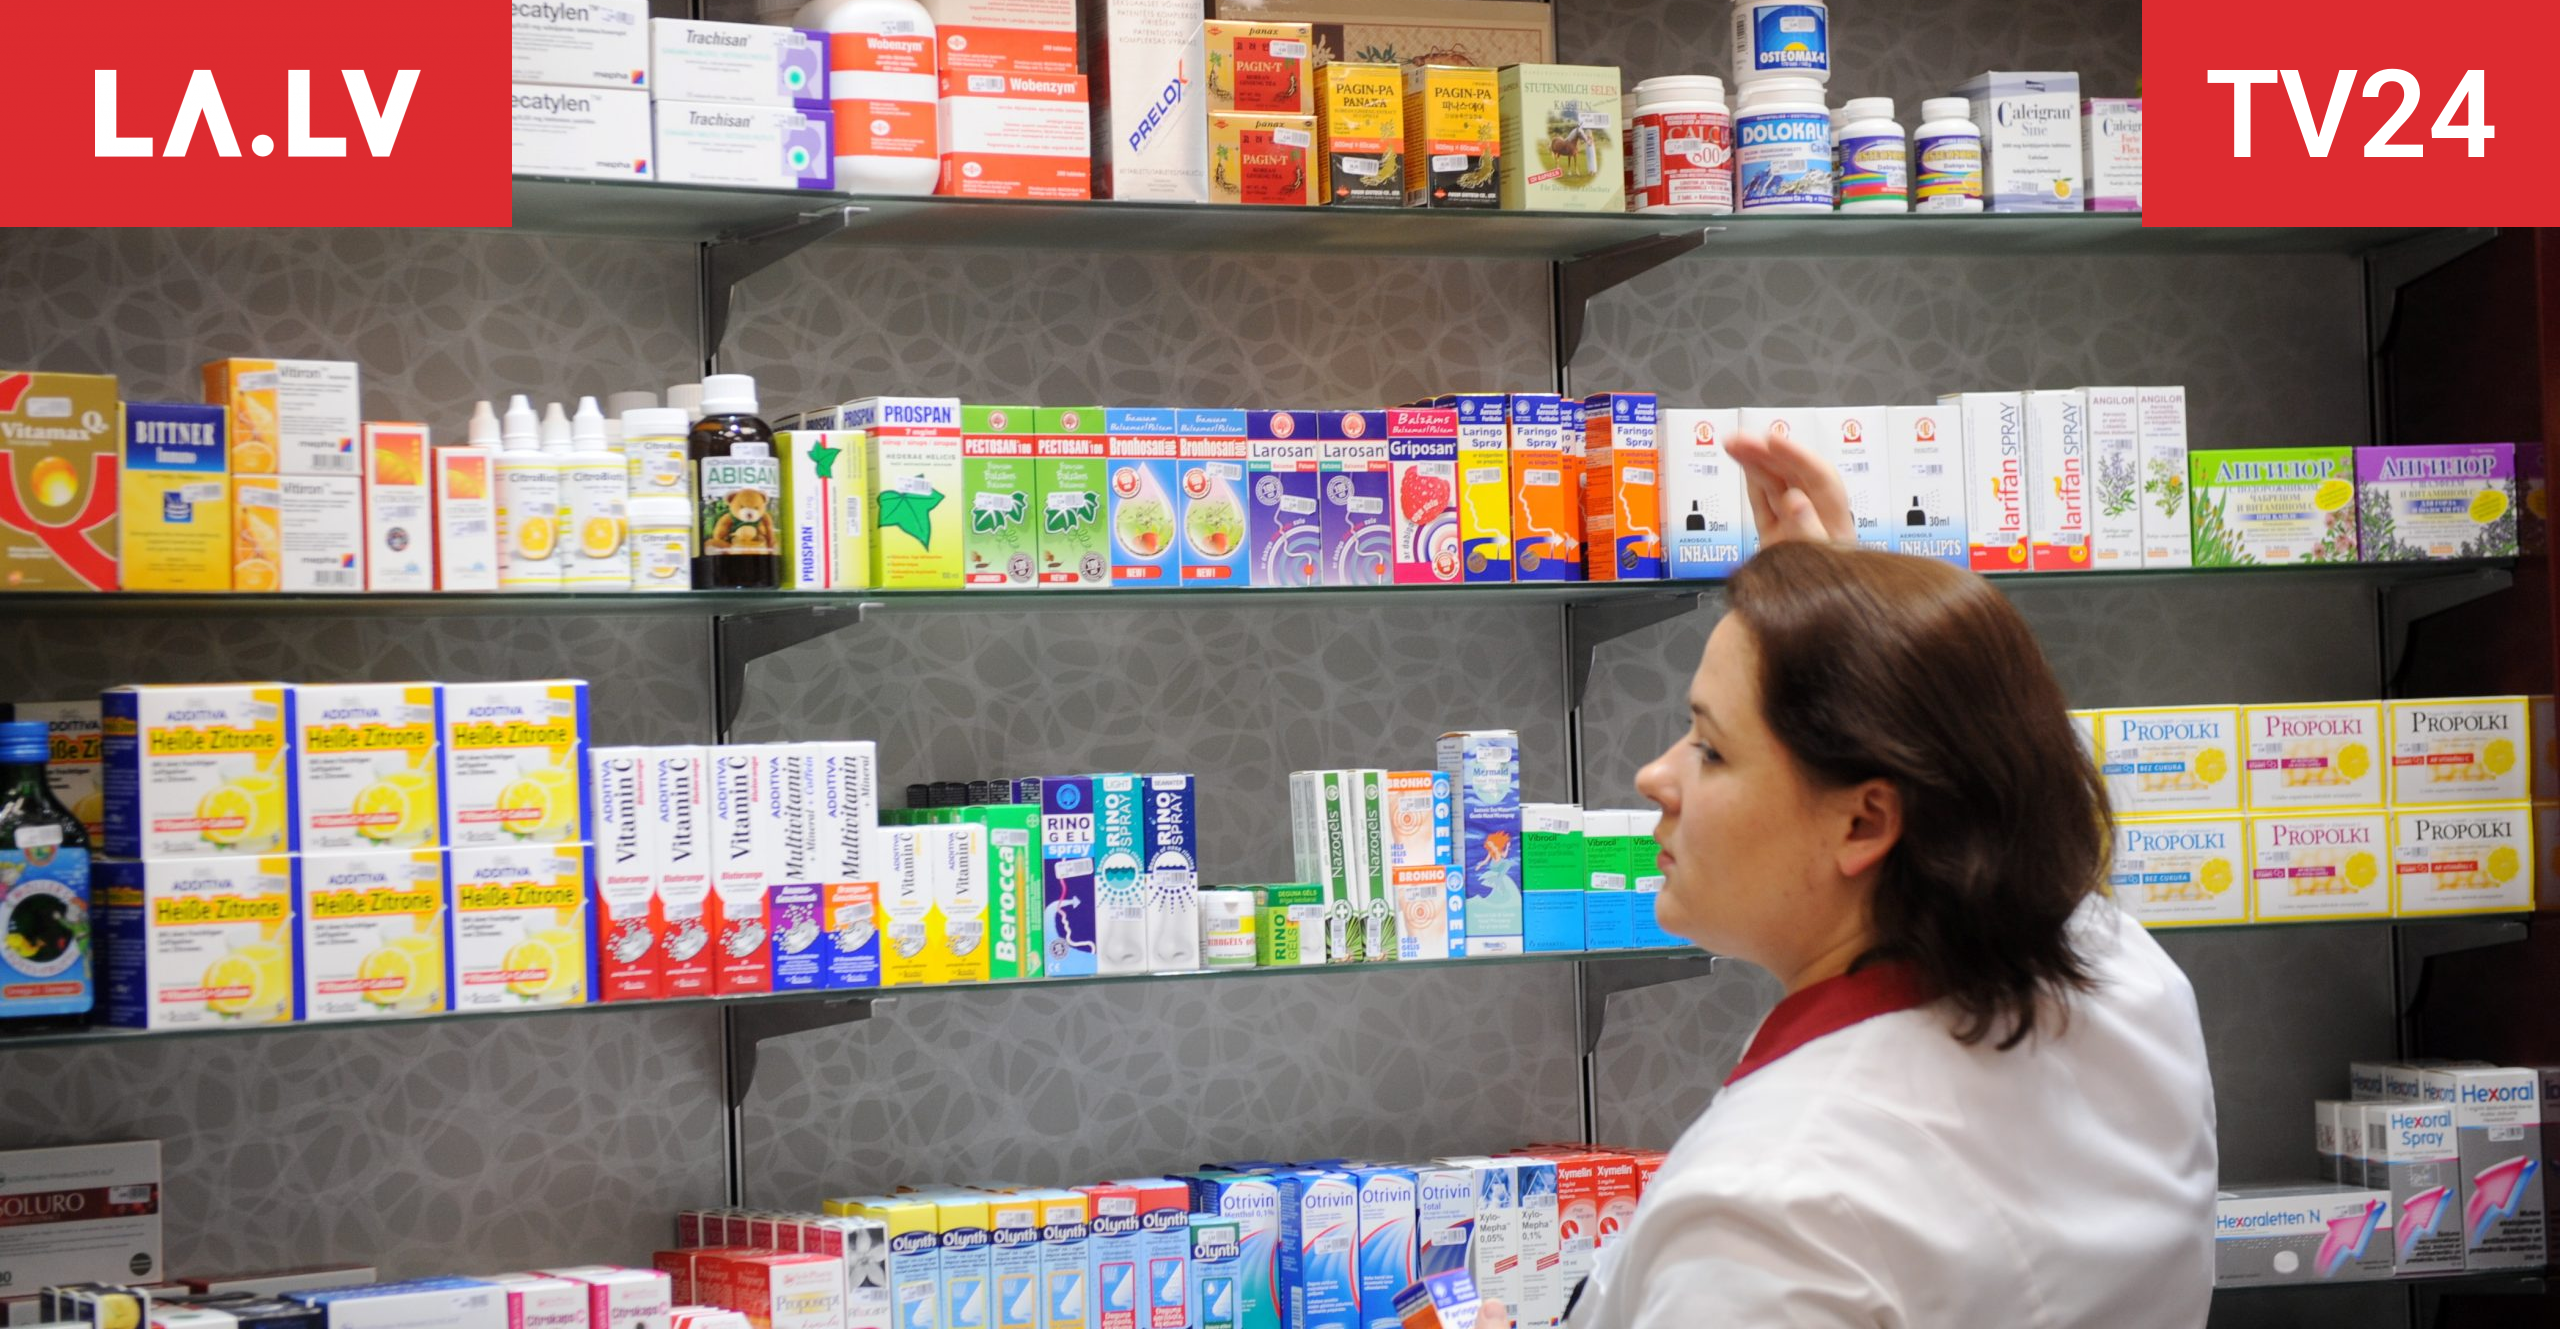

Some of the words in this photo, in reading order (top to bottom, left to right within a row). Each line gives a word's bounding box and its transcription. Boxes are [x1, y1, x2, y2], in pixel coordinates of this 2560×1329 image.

[686, 29, 748, 47] Trachisan
[1249, 27, 1278, 36] panax
[867, 38, 922, 53] Wobenzym
[1236, 61, 1283, 72] PAGIN-T
[1010, 77, 1076, 95] Wobenzym
[1336, 84, 1394, 96] PAGIN-PA
[1435, 87, 1492, 99] PAGIN-PA
[1524, 83, 1588, 94] STUTENMILCH
[1591, 85, 1617, 95] SELEN
[1128, 58, 1188, 152] PRELOX
[689, 111, 751, 128] Trachisan
[1998, 101, 2070, 127] Calcigran
[1255, 120, 1285, 129] panax
[2022, 123, 2047, 136] Sine
[1243, 155, 1289, 165] PAGIN-T
[2093, 397, 2135, 405] ANGILOR
[2141, 395, 2183, 404] ANGILOR
[885, 406, 951, 423] PROSPAN
[1397, 413, 1450, 425] Balzāms
[1, 421, 90, 441] Vitamax
[135, 421, 215, 446] BITTNER
[1462, 427, 1503, 438] Laringo
[1517, 427, 1558, 438] Faringo
[1617, 427, 1654, 438] Faringo
[2001, 402, 2017, 456] SPRAY
[2063, 402, 2079, 455] SPRAY
[965, 439, 1017, 454] PECTOSAN
[1038, 439, 1089, 454] PECTOSAN
[1109, 438, 1164, 459] Bronhosan
[1179, 438, 1234, 459] Bronhosan
[1253, 444, 1313, 458] Larosan
[1324, 444, 1384, 458] Larosan
[1390, 441, 1454, 458] Griposan
[1472, 438, 1503, 449] Spray
[1526, 438, 1557, 449] Spray
[1625, 437, 1653, 448] Spray
[708, 466, 777, 484] ABISAN
[2216, 460, 2334, 483] АНГИЛОР
[2380, 456, 2496, 480] АНГИЛОР
[1991, 458, 2020, 531] larifan
[2053, 458, 2082, 531] larifan
[1708, 520, 1728, 532] 30ml
[1857, 517, 1878, 528] 30ml
[1929, 516, 1950, 527] 30ml
[801, 526, 814, 582] PROSPAN
[1679, 545, 1739, 563] INHALIPTS
[1899, 539, 1962, 557] INHALIPTS
[166, 710, 227, 722] ADDITIVA
[322, 708, 381, 720] ADDITIVA
[467, 706, 523, 718] ADDITIVA
[152, 732, 206, 751] Heiße
[210, 730, 274, 750] Zitrone
[309, 728, 359, 748] Heiße
[363, 726, 426, 746] Zitrone
[456, 727, 503, 745] Heiße
[507, 725, 567, 744] Zitrone
[613, 758, 634, 772] C
[670, 758, 690, 772] C
[728, 756, 749, 770] C
[2139, 764, 2152, 772] BEZ
[1473, 767, 1509, 777] Mermaid
[601, 760, 613, 823] ADDITIVA
[658, 759, 669, 823] ADDITIVA
[716, 757, 728, 820] ADDITIVA
[769, 757, 780, 818] ADDITIVA
[825, 757, 837, 818] ADDITIVA
[1105, 780, 1129, 789] LIGHT
[1388, 777, 1432, 789] BRONHO
[614, 778, 637, 864] Vitamin
[670, 778, 692, 863] Vitamin
[729, 777, 750, 860] Vitamin
[783, 756, 805, 881] Multivitamin
[839, 756, 860, 880] Multivitamin
[1048, 818, 1090, 830] RINO
[1105, 793, 1120, 847] RINO
[1120, 793, 1133, 847] SPRAY
[1157, 792, 1171, 846] RINO
[1171, 792, 1185, 846] SPRAY
[1049, 832, 1090, 842] GEL
[1435, 802, 1450, 857] GEL
[1528, 833, 1557, 843] Vibrocil
[1049, 843, 1091, 857] spray
[1328, 810, 1343, 879] Nazogels
[1368, 808, 1381, 878] Nazogels
[1587, 838, 1617, 848] Vibrocil
[474, 867, 531, 879] ADDITIVA
[901, 842, 914, 897] Vitamin
[956, 841, 969, 895] Vitamin
[1399, 870, 1445, 882] BRONHO
[172, 879, 234, 891] ADDITIVA
[328, 873, 387, 885] ADDITIVA
[2144, 874, 2157, 882] BEZ
[315, 894, 365, 914] Heiße
[370, 892, 432, 912] Zitrone
[462, 888, 510, 907] Heiße
[514, 886, 574, 905] Zitrone
[996, 846, 1017, 962] Berocca
[158, 900, 211, 921] Heiße
[216, 898, 281, 919] Zitrone
[1449, 897, 1464, 950] GEL
[1274, 914, 1286, 960] RINO
[2461, 1080, 2534, 1104] Hexoral
[2391, 1110, 2452, 1131] Hexoral
[2402, 1132, 2444, 1149] Spray
[1559, 1168, 1592, 1180] Xymelin
[1597, 1165, 1632, 1177] Xymelin
[1305, 1193, 1354, 1210] Otrivin
[1362, 1189, 1411, 1205] Otrivin
[1423, 1186, 1471, 1200] Otrivin
[1223, 1195, 1274, 1211] Otrivin
[1143, 1211, 1188, 1230] Olynth
[1480, 1213, 1501, 1224] Xylo-
[1522, 1210, 1543, 1220] Xylo-
[2217, 1210, 2304, 1230] Hexoraletten
[2309, 1210, 2321, 1224] N
[1043, 1224, 1087, 1243] Olynth
[1093, 1217, 1139, 1236] Olynth
[1480, 1223, 1507, 1235] Mepha
[1522, 1220, 1549, 1231] Mepha
[893, 1234, 937, 1254] Olynth
[942, 1230, 988, 1250] Olynth
[993, 1228, 1038, 1246] Olynth
[1480, 1233, 1504, 1243] 0,05%
[1522, 1231, 1542, 1241] 0,1%
[1194, 1242, 1240, 1262] Olynth
